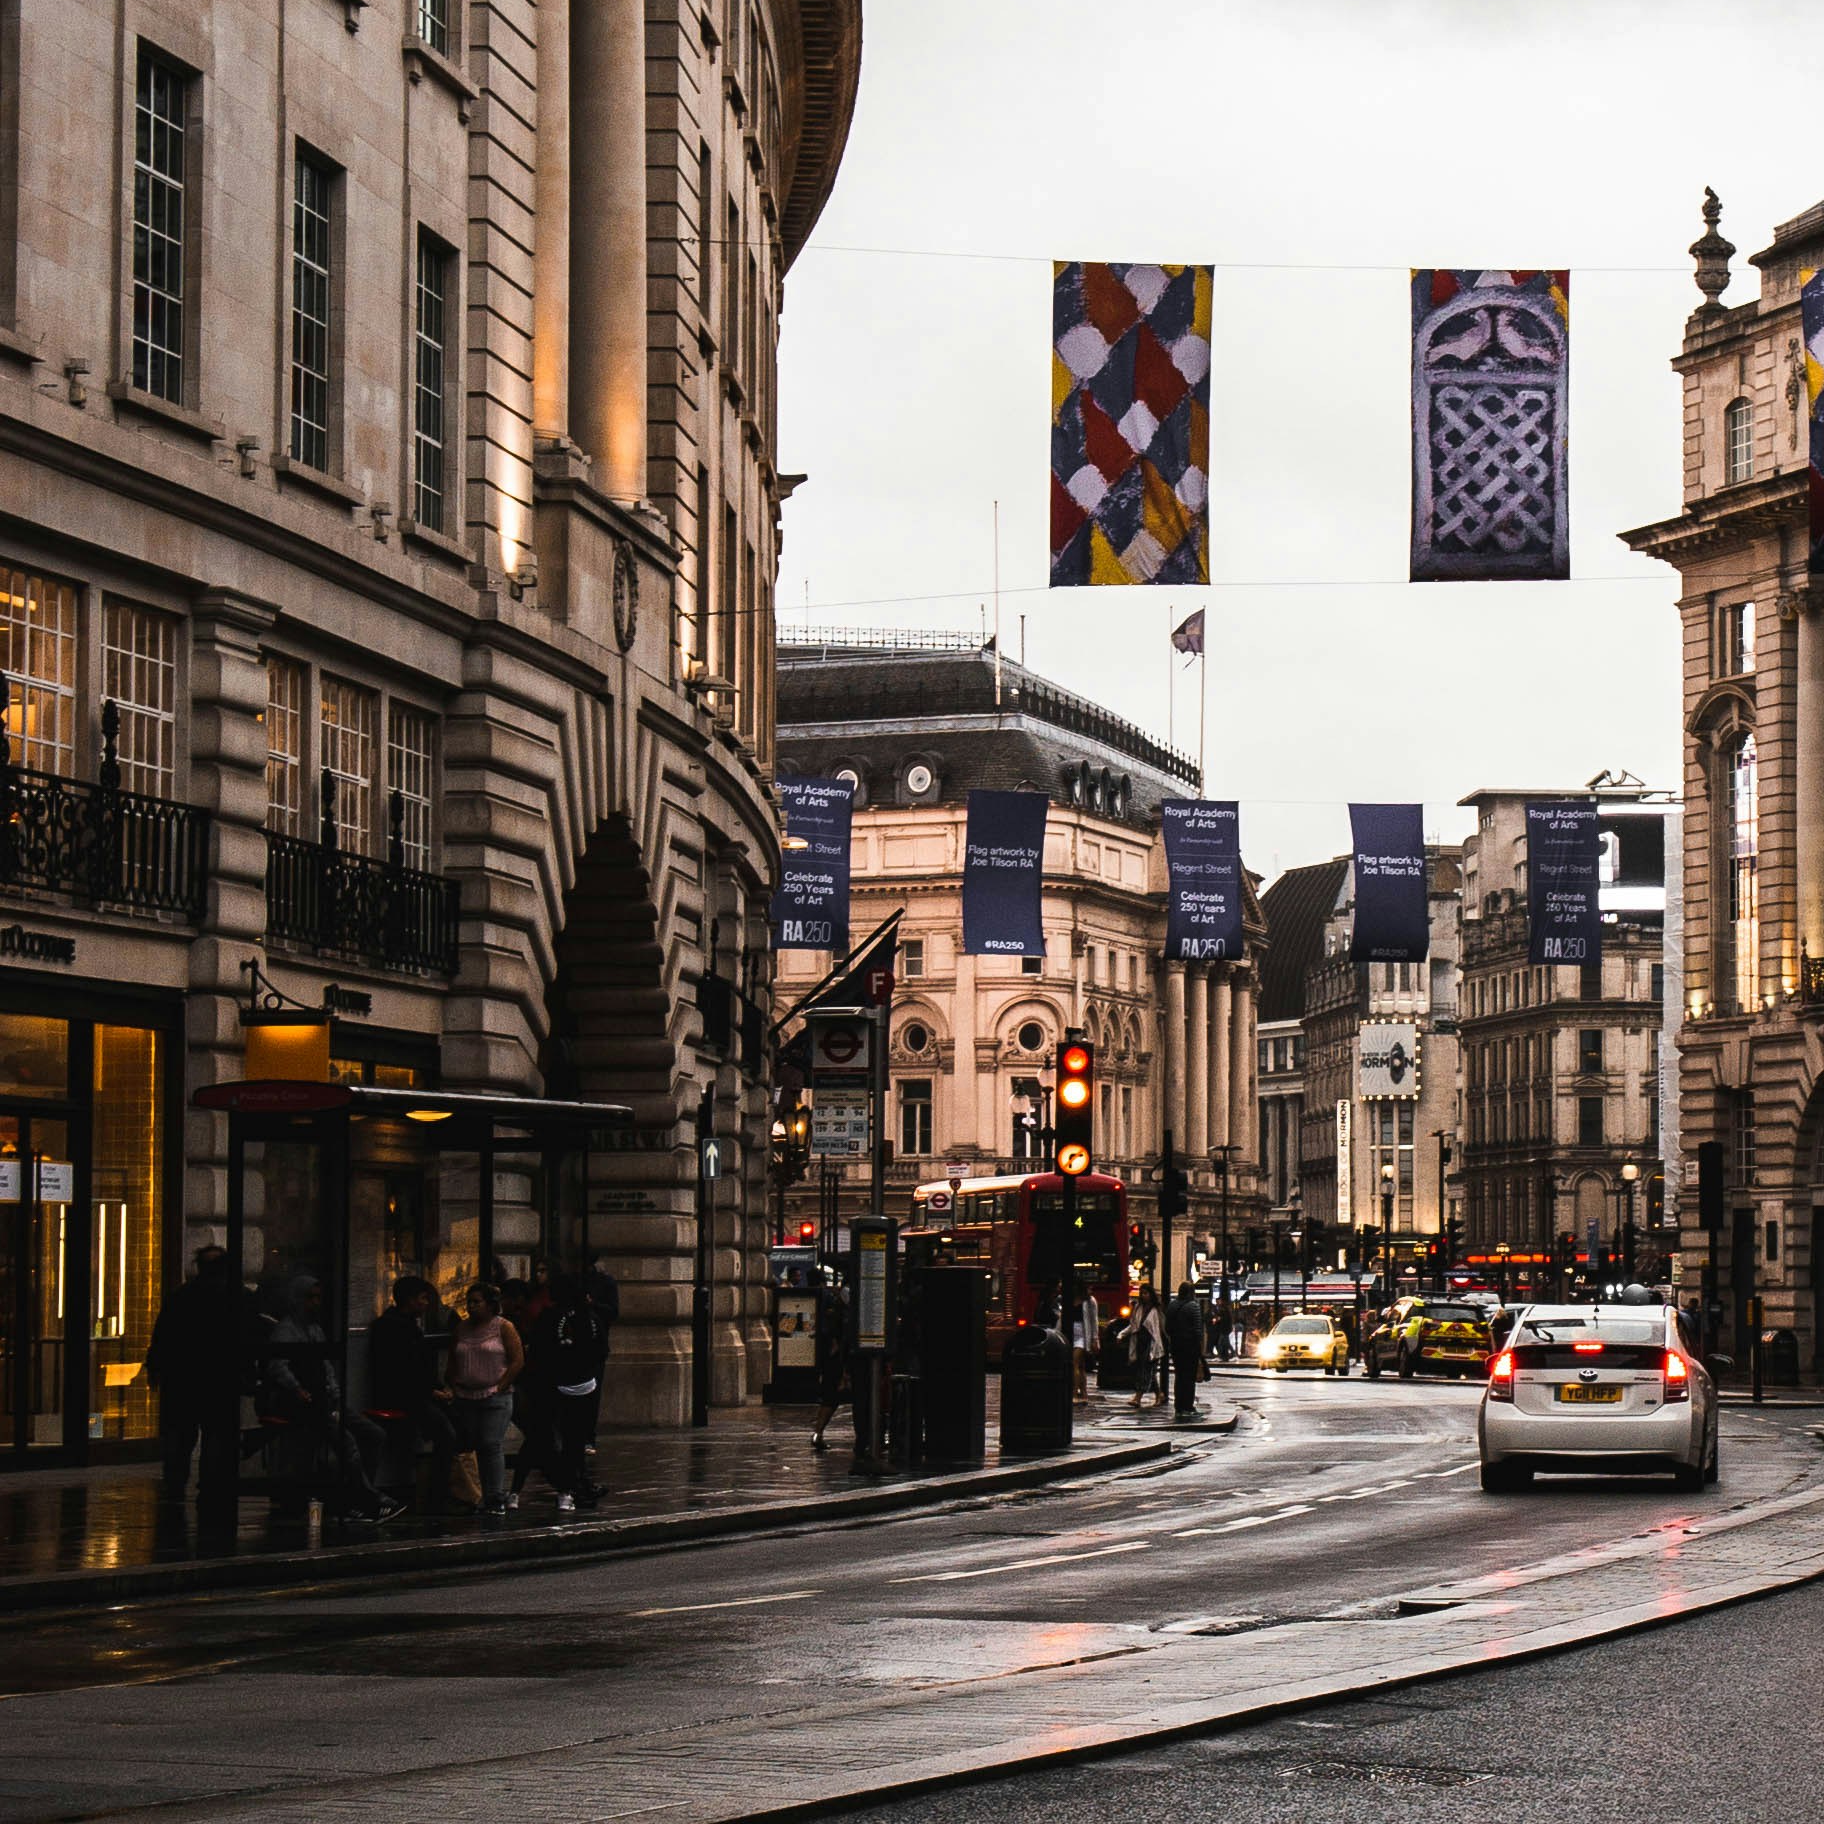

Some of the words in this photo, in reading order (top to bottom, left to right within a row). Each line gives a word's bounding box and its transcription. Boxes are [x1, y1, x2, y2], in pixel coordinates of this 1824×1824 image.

[775, 782, 802, 794] Royal
[804, 785, 851, 800] Academy
[795, 796, 806, 805] of
[808, 797, 829, 807] Arts
[1164, 806, 1191, 818] Royal
[1193, 808, 1236, 820] Academy
[1529, 809, 1554, 821] Royal
[1556, 809, 1596, 821] Academy
[1185, 819, 1195, 828] of
[1197, 819, 1217, 828] Arts
[1549, 820, 1559, 829] of
[1560, 820, 1579, 829] Arts
[815, 843, 841, 854] Street
[968, 845, 988, 856] Flag
[989, 847, 1025, 856] artwork
[1027, 848, 1040, 859] by
[971, 856, 988, 866] Joe
[990, 857, 1017, 867] Tilson
[1020, 858, 1034, 868] RA
[1358, 854, 1377, 866] Flag
[1378, 856, 1412, 865] artwork
[1413, 857, 1423, 868] by
[1172, 862, 1203, 875] Regent
[1205, 863, 1232, 874] Street
[1362, 865, 1378, 875] Joe
[1380, 865, 1406, 875] Tilson
[1407, 867, 1420, 876] RA
[1540, 863, 1568, 876] Regent
[1569, 864, 1592, 874] Street
[784, 871, 833, 884] Celebrate
[783, 883, 803, 892] 250
[805, 884, 834, 894] Years
[794, 895, 805, 904] of
[807, 896, 823, 905] Art
[1180, 891, 1225, 902] Celebrate
[1546, 892, 1587, 902] Celebrate
[1180, 902, 1197, 912] 250
[1199, 903, 1226, 913] Years
[1545, 903, 1561, 912] 250
[1562, 903, 1587, 913] Years
[1190, 913, 1200, 922] of
[1200, 914, 1215, 924] Art
[1554, 913, 1564, 923] of
[1565, 914, 1577, 923] Art
[782, 920, 831, 943] RA250
[1544, 938, 1586, 958] RA250
[872, 972, 885, 995] F
[1073, 1216, 1083, 1226] 4
[1592, 1387, 1617, 1401] HFP
